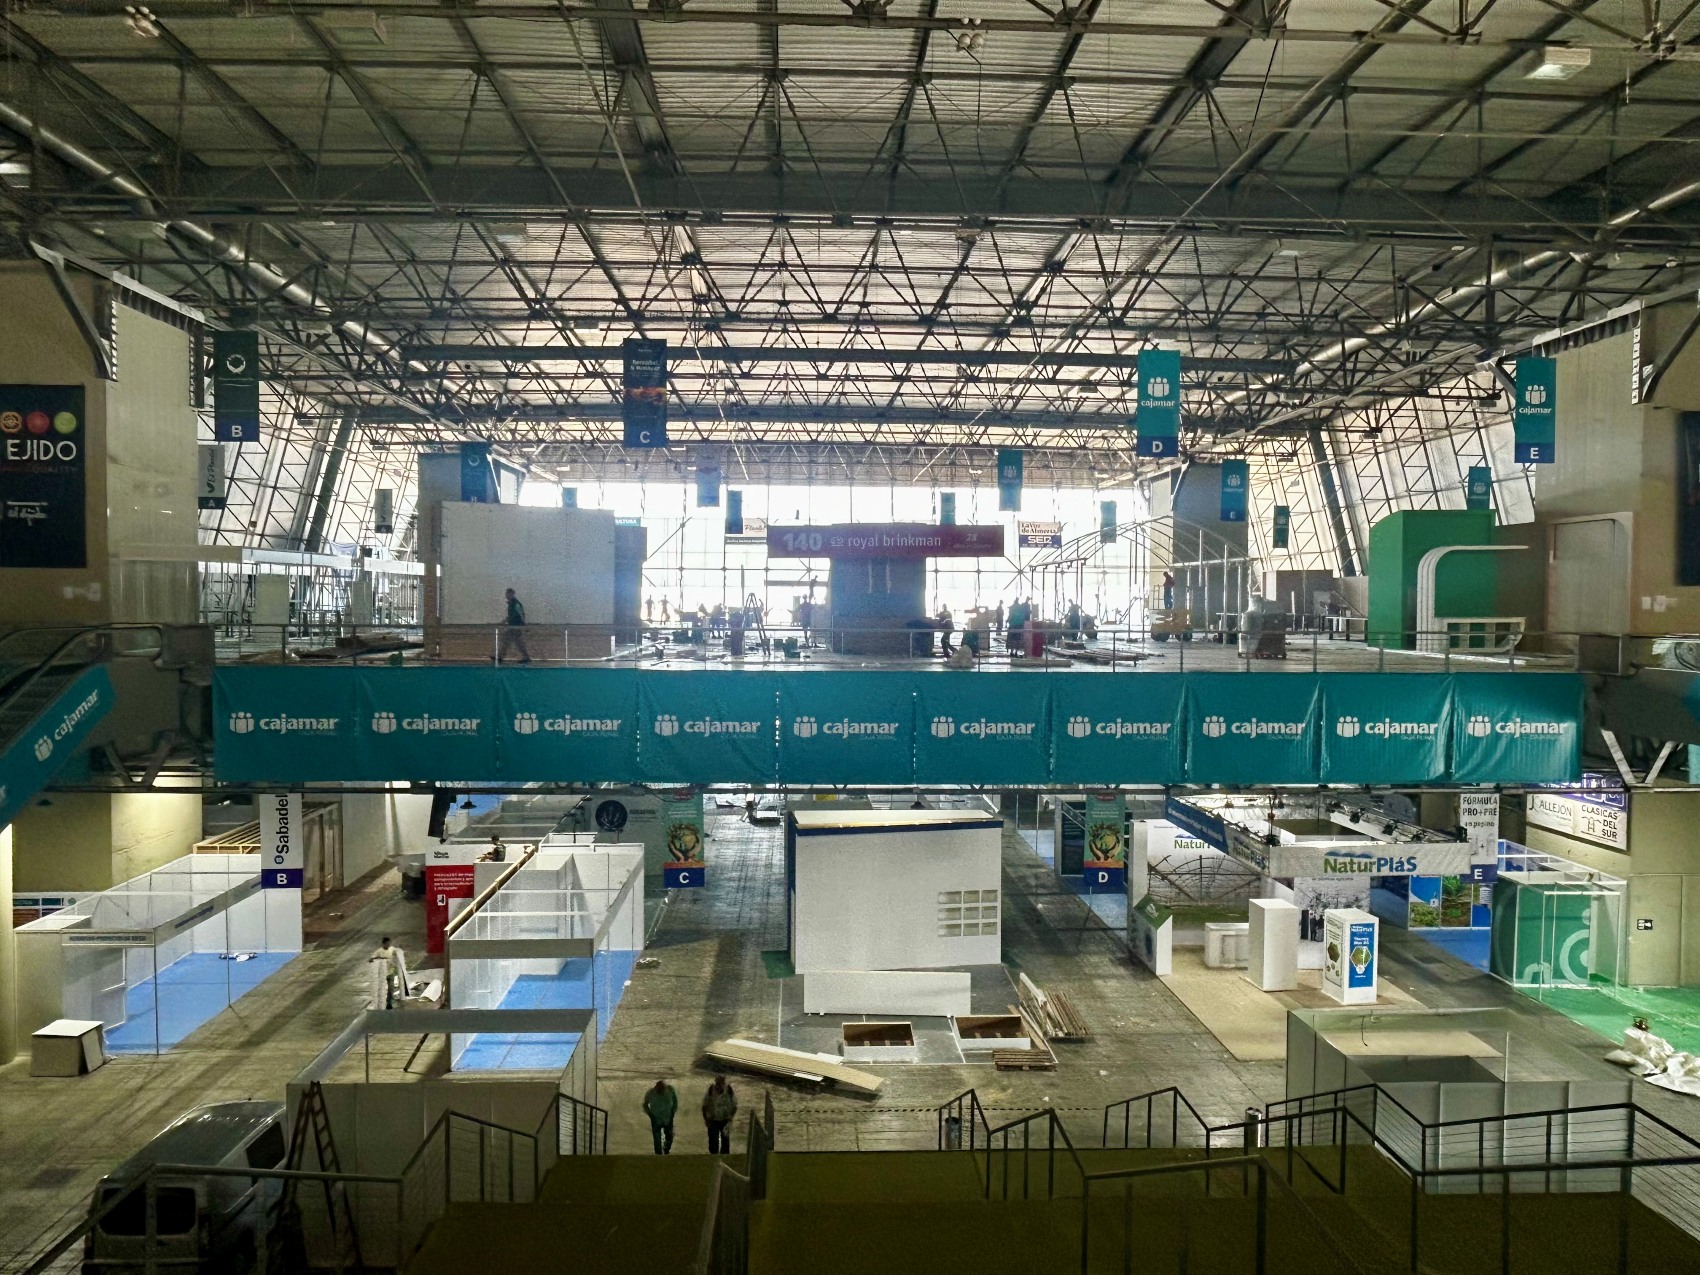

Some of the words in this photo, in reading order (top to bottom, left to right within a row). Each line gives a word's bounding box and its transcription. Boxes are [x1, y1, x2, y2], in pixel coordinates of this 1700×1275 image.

[1141, 398, 1175, 409] cajamar
[1519, 405, 1552, 415] cajamar
[231, 425, 242, 438] B
[640, 431, 651, 443] C
[7, 440, 77, 461] EJIDO
[1152, 440, 1163, 453] D
[1530, 447, 1539, 459] E
[783, 533, 823, 551] 140
[848, 535, 879, 549] royal
[883, 532, 941, 547] brinkman
[54, 689, 98, 741] cajamar
[259, 715, 339, 735] cajamar
[402, 715, 481, 735] cajamar
[543, 715, 622, 735] cajamar
[683, 717, 761, 736] cajamar
[823, 718, 899, 738] cajamar
[960, 719, 1035, 738] cajamar
[1096, 719, 1172, 738] cajamar
[1231, 718, 1306, 738] cajamar
[1365, 718, 1438, 738] cajamar
[1496, 717, 1568, 738] cajamar
[274, 794, 290, 854] Sabadel
[1601, 828, 1618, 839] SUR
[1602, 819, 1618, 830] DEL
[1323, 856, 1418, 874] NaturPláS
[1474, 868, 1483, 880] E
[276, 873, 288, 885] B
[679, 871, 690, 884] C
[1098, 871, 1109, 883] D
